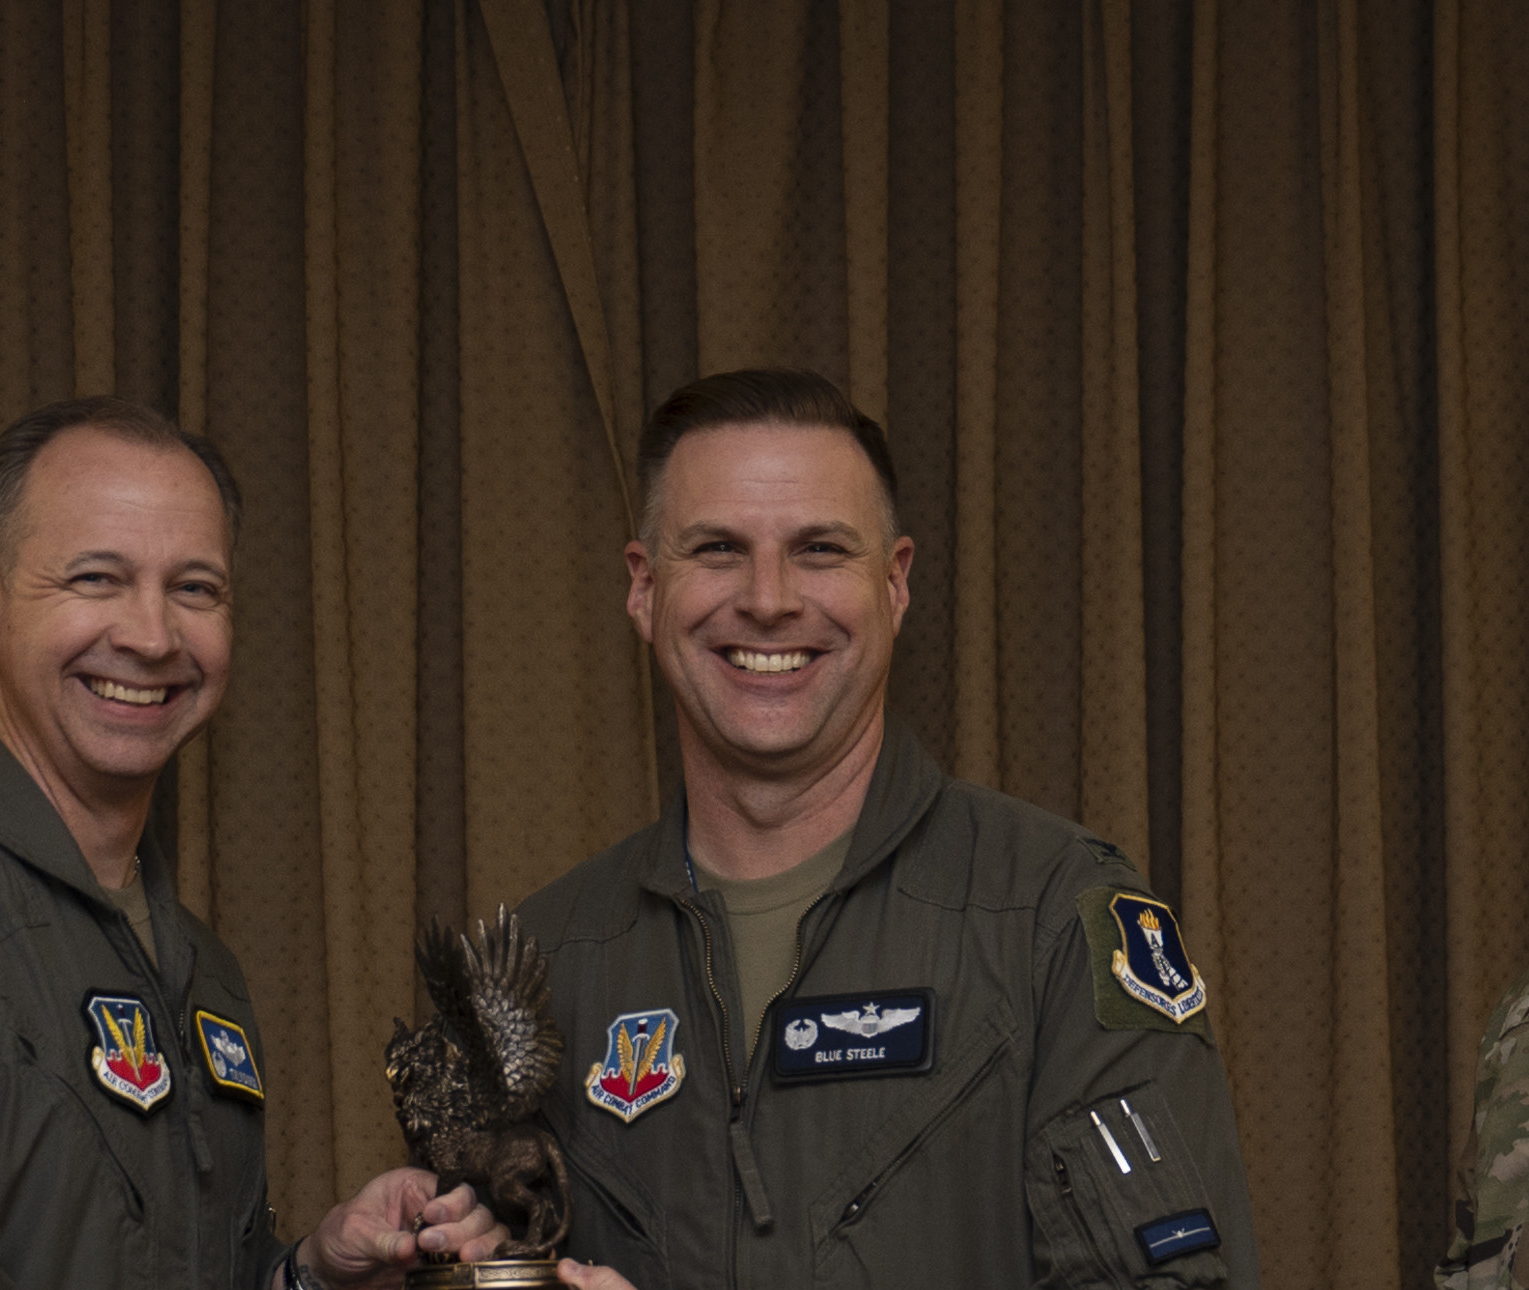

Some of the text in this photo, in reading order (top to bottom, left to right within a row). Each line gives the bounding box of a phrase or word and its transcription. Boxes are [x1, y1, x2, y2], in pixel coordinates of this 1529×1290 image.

[815, 1046, 886, 1063] BLUE STEELE
[591, 1075, 677, 1116] AIR COMBAT COMMAND
